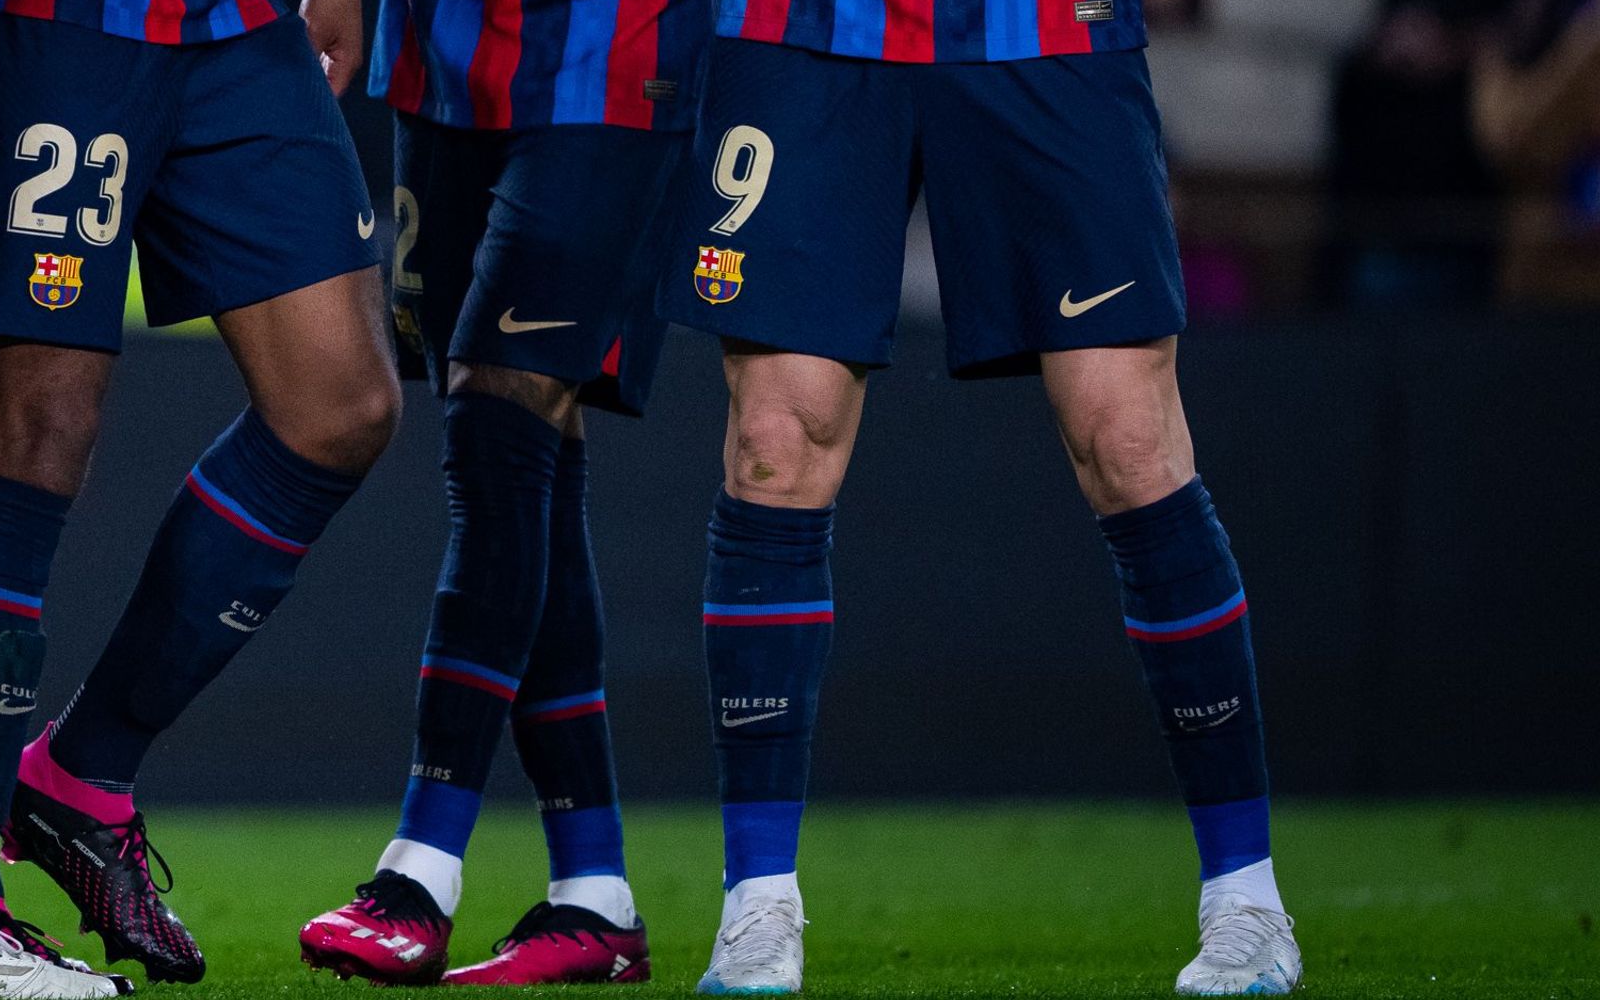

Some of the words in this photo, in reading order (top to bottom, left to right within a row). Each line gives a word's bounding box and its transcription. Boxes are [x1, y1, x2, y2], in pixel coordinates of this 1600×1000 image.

[6, 123, 129, 246] 23
[708, 124, 775, 237] 9
[707, 269, 727, 279] FCB
[231, 600, 266, 621] CUL
[721, 697, 789, 709] CULERS
[1173, 696, 1240, 718] CULERS
